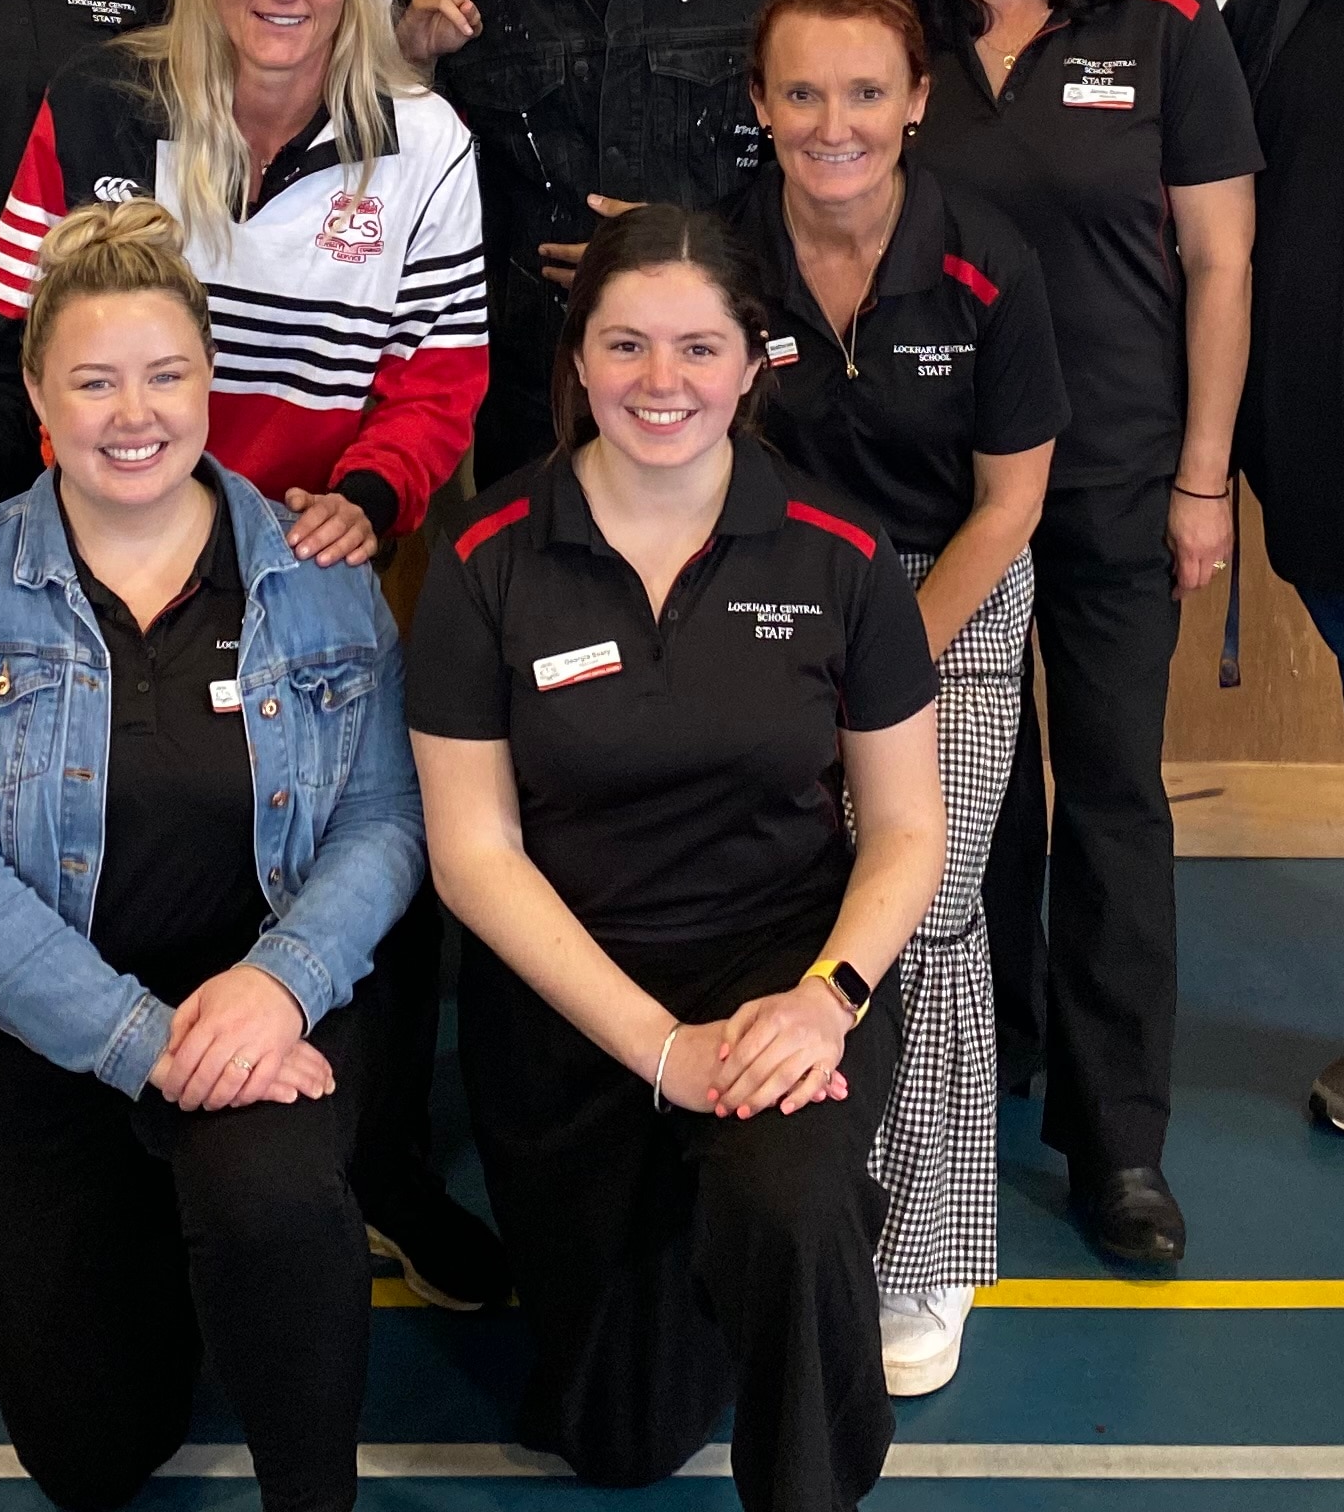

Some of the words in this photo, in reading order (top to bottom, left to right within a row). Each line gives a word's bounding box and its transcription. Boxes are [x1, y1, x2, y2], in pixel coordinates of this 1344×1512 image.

[1063, 57, 1101, 68] LOCKHART
[1102, 59, 1137, 68] CENTRAL
[1082, 76, 1114, 85] STAFF
[328, 214, 378, 237] CLS
[893, 345, 936, 353] LOCKHART
[938, 344, 976, 353] CENTRAL
[919, 353, 952, 362] SCHOOL
[917, 365, 952, 376] STAFF
[727, 601, 777, 613] LOCKHART
[779, 604, 823, 614] CENTRAL
[757, 613, 793, 623] SCHOOL
[755, 625, 794, 639] STAFF
